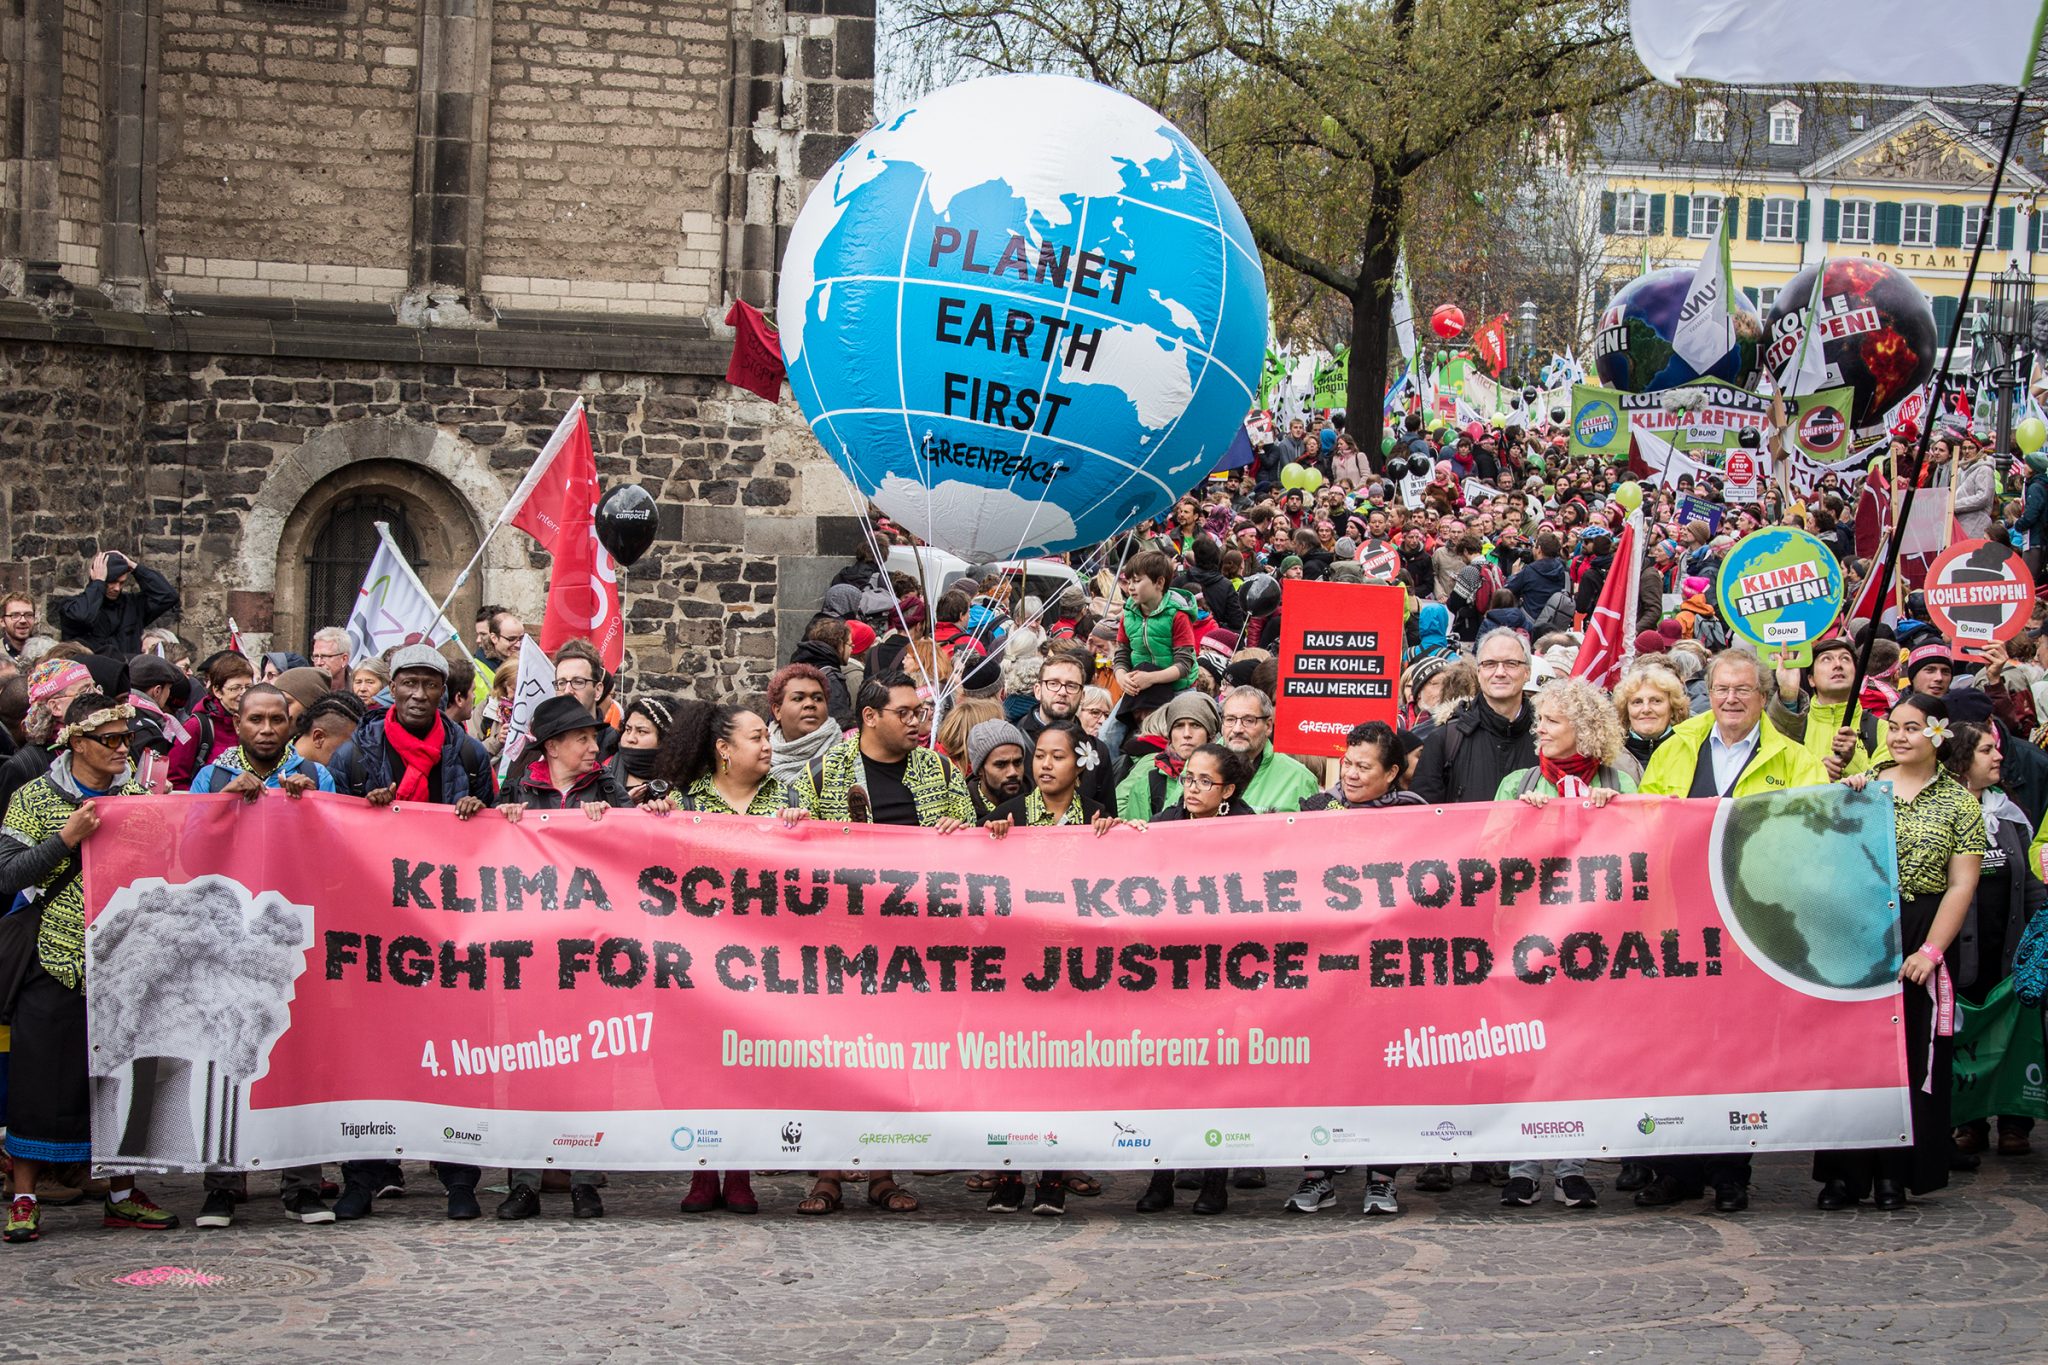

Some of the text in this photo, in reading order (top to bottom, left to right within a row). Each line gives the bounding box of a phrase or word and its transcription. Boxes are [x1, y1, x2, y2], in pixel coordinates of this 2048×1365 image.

[929, 226, 1136, 305] PLANET
[936, 297, 1103, 373] EARTH
[944, 372, 1072, 437] FIRST
[1582, 415, 1608, 427] KLIMA
[1632, 410, 1695, 428] KLIMA
[1800, 426, 1818, 437] KOHLE
[921, 436, 1070, 486] GREENPEACE
[1743, 563, 1815, 594] KLIMA
[1738, 578, 1829, 616] RETTEN!
[1928, 583, 2028, 605] KOHLE STOPPEN!
[1777, 627, 1798, 635] BUND
[1306, 634, 1375, 648] RAUS AUS
[1298, 658, 1380, 674] DER KOHLE,
[1288, 682, 1388, 696] FRAU MERKEL!
[392, 857, 614, 913] KLIMA
[638, 865, 1012, 918] SCHÜTZEN
[1071, 869, 1302, 917] KOHLE
[1322, 851, 1650, 911] STOPPEN!
[324, 930, 533, 991] FIGHT
[557, 936, 695, 990] FOR
[714, 944, 1007, 995] CLIMATE
[1022, 941, 1309, 993] JUSTICE
[1370, 936, 1495, 988] END
[1512, 926, 1723, 986] COAL!
[421, 1012, 654, 1077] 4. November 2017
[722, 1027, 1310, 1070] Demonstration zur Weltklimakonferenz in Bonn
[1383, 1017, 1547, 1069] #klimademo
[1729, 1110, 1767, 1125] Brot
[340, 1121, 396, 1139] Trägerkreis:
[697, 1128, 718, 1136] Klima
[1521, 1120, 1584, 1136] MISEREOR
[455, 1131, 482, 1142] BUND
[552, 1132, 604, 1148] campact!
[697, 1135, 722, 1143] Allianz
[859, 1133, 932, 1145] GREENPEACE
[987, 1132, 1038, 1141] NaturFreunde
[1117, 1138, 1151, 1147] NABU
[1225, 1133, 1250, 1142] OXFAM
